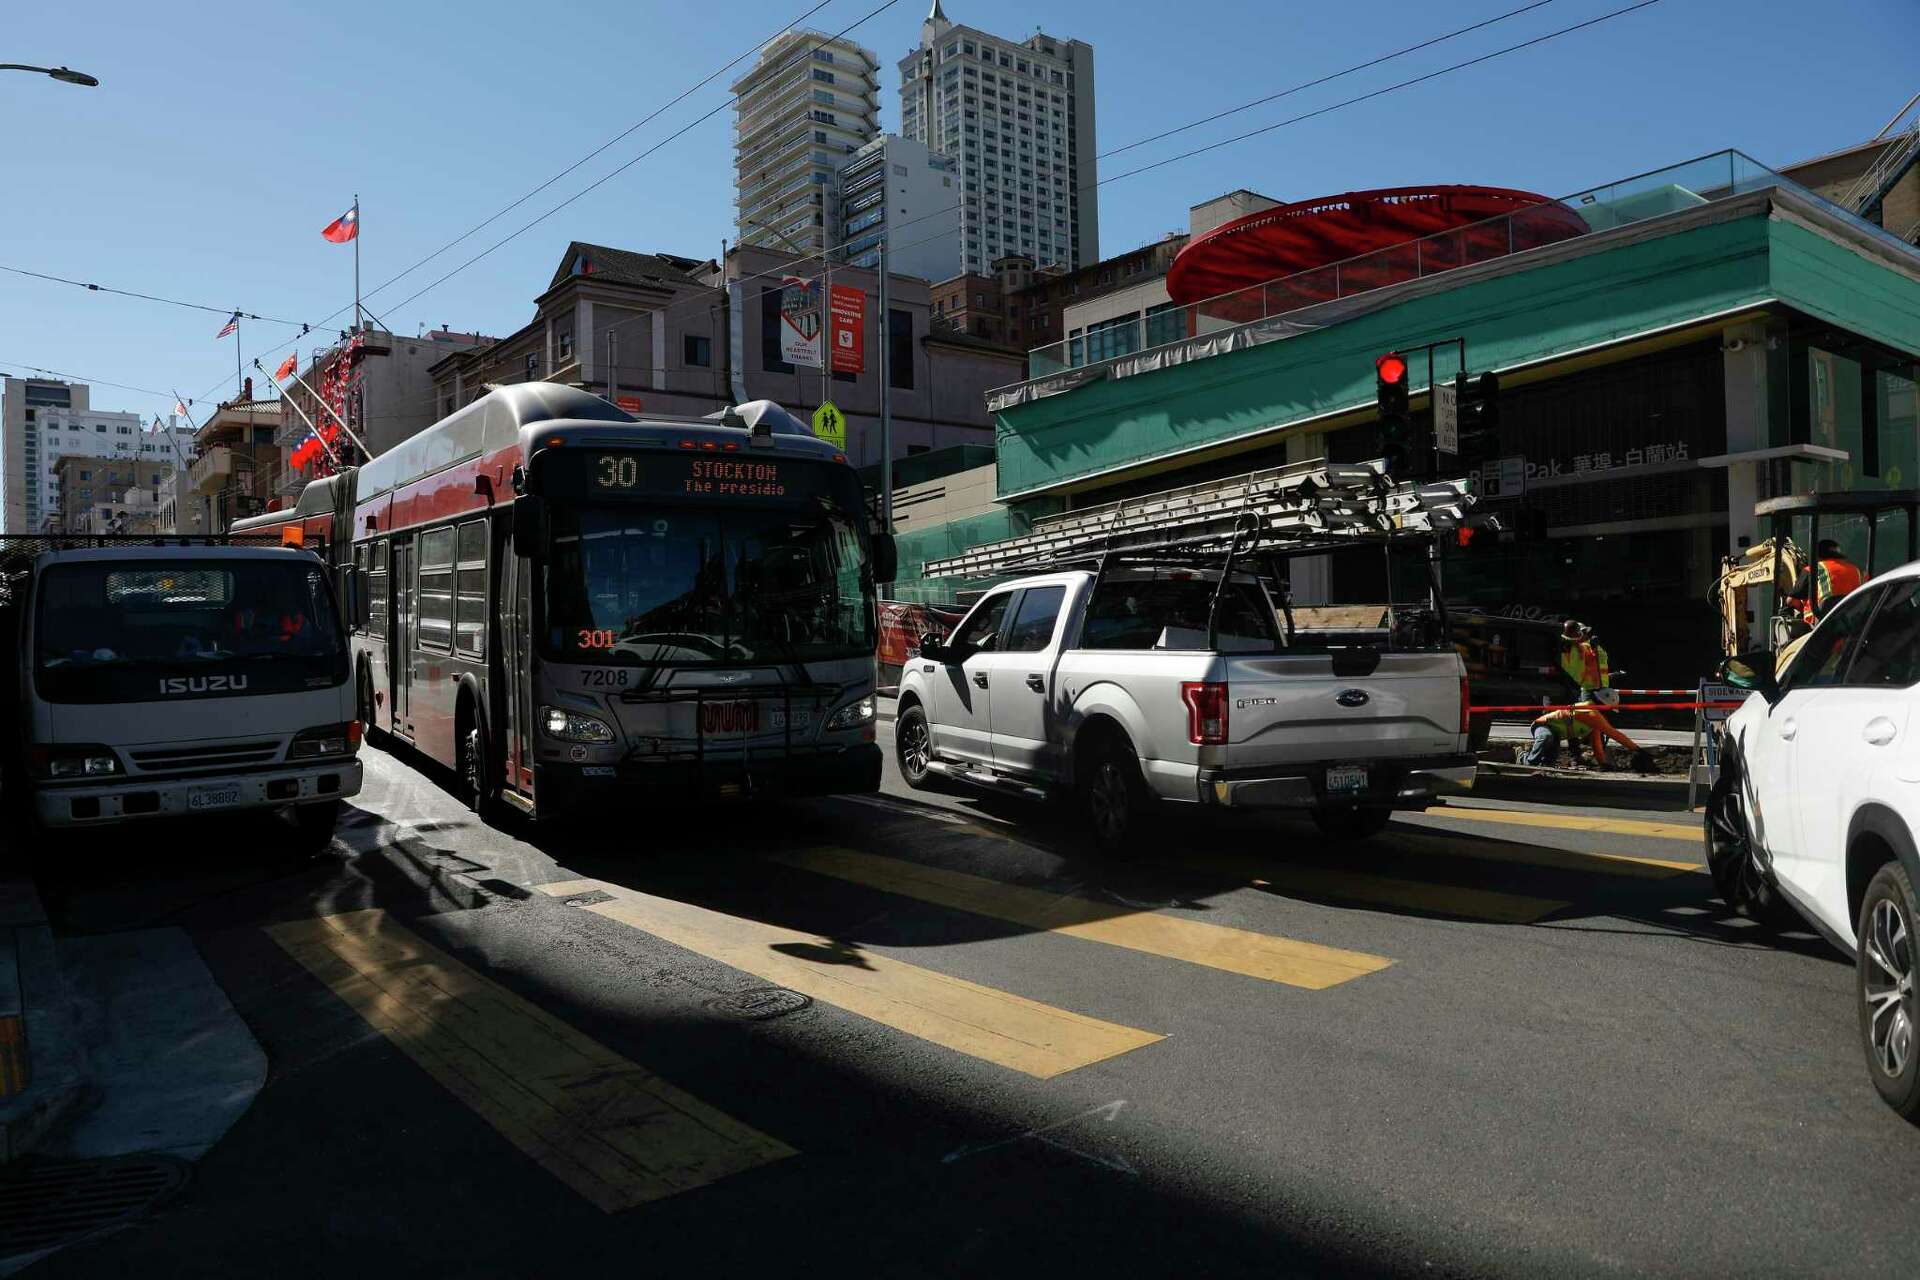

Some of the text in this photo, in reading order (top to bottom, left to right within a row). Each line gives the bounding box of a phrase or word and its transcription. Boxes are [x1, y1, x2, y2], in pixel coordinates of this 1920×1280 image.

[598, 456, 638, 488] 30
[691, 460, 778, 481] STOCKTON
[1525, 460, 1560, 480] Pak
[683, 480, 785, 496] The Presidio
[577, 628, 617, 650] 301
[159, 673, 248, 694] ISUZU
[580, 670, 628, 687] 7208
